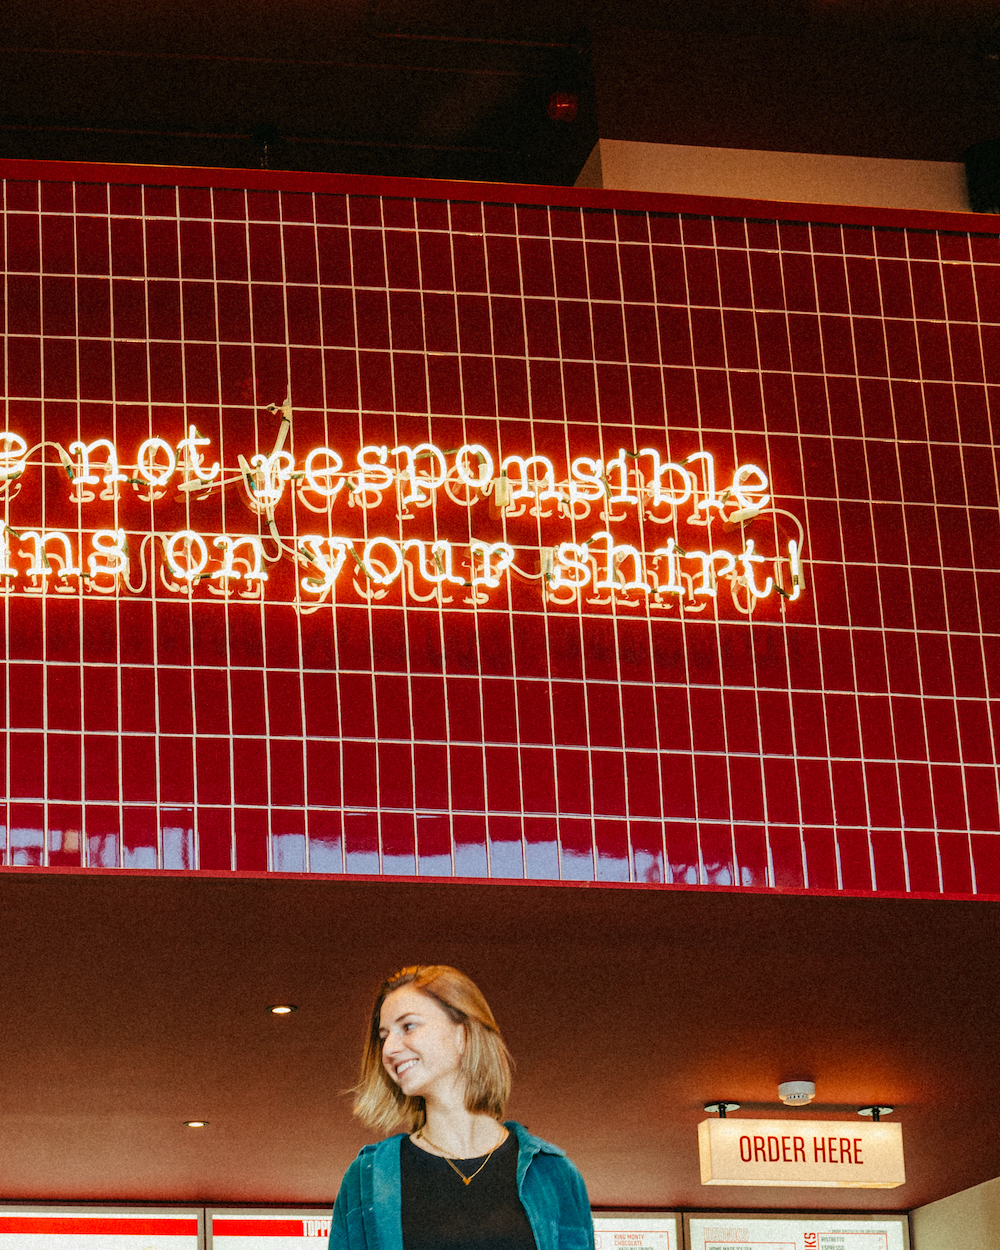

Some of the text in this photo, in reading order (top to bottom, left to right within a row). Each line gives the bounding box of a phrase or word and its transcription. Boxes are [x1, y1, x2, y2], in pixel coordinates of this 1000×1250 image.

[69, 424, 221, 485] not
[165, 529, 268, 581] on
[298, 534, 515, 595] your
[739, 1135, 865, 1165] ORDER HERE
